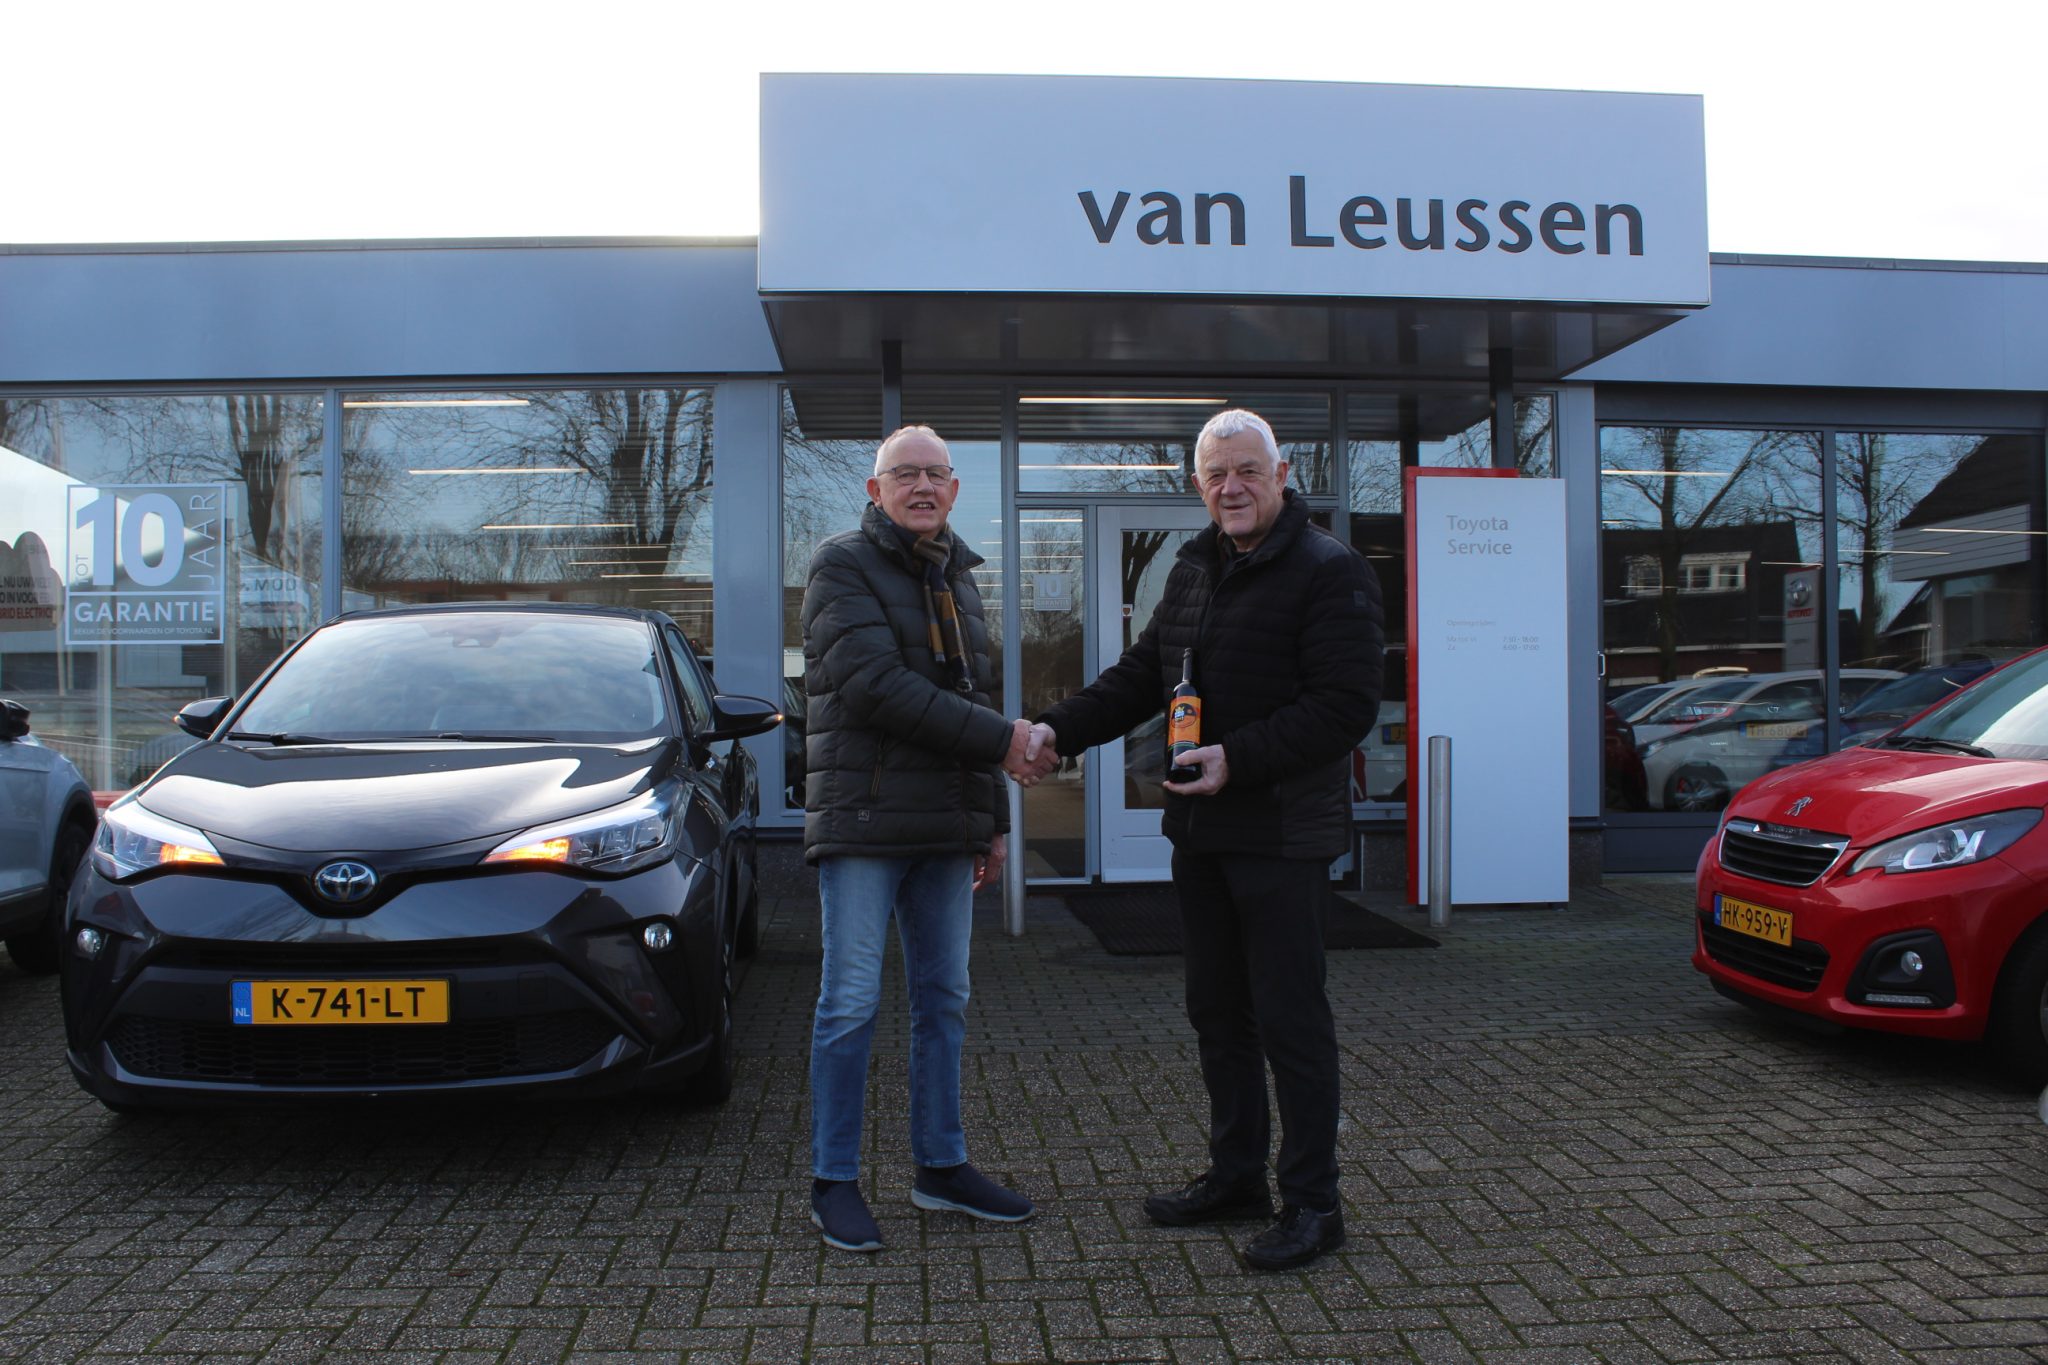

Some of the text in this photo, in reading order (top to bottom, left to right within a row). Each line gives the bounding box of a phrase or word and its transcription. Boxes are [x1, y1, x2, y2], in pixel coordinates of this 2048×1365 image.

[1077, 175, 1644, 256] van Leussen
[76, 492, 185, 587] 10
[189, 493, 216, 586] JAAR
[1446, 515, 1509, 535] Toyota
[1447, 539, 1512, 555] Service
[75, 554, 89, 587] TOT
[74, 601, 215, 623] GARANTIE
[1724, 902, 1787, 940] HK-959-V
[235, 1007, 250, 1017] NL
[271, 987, 426, 1018] K-741-LT
